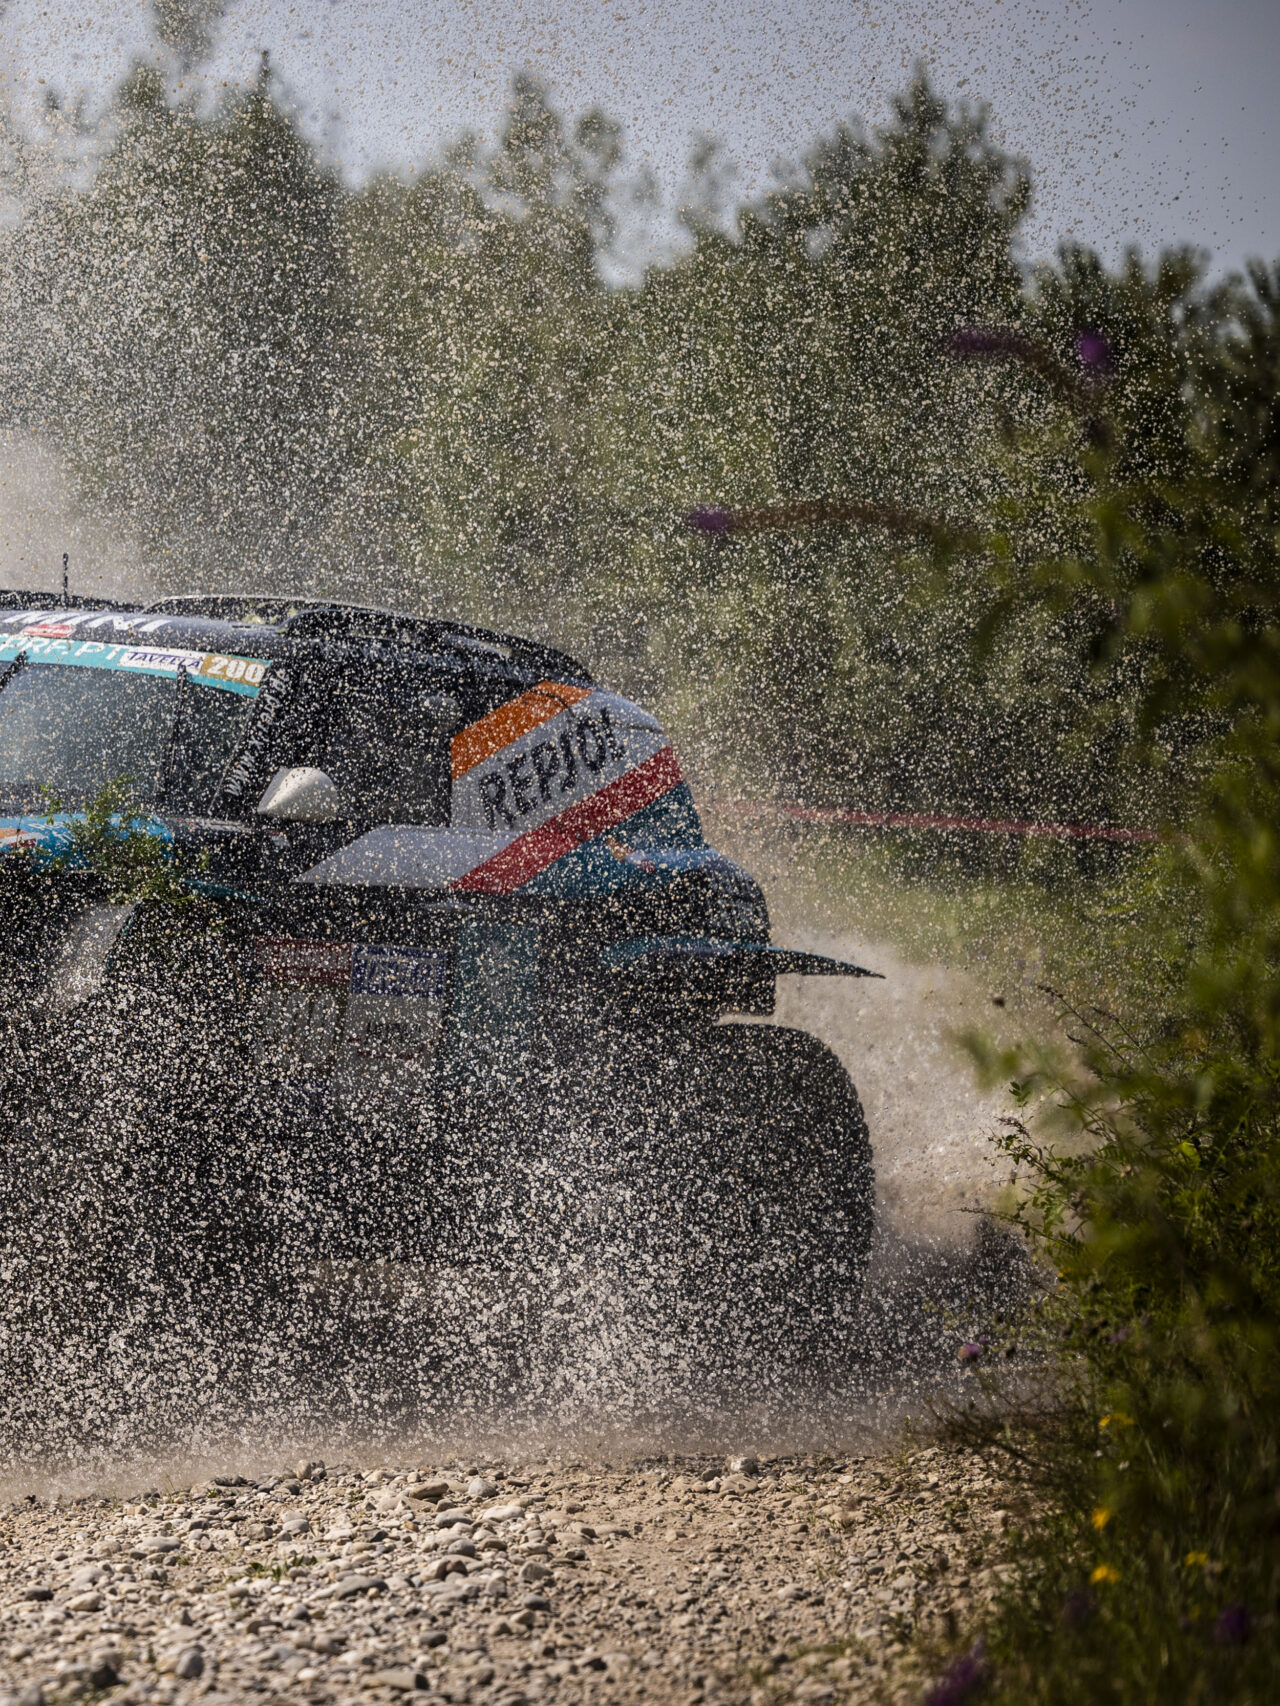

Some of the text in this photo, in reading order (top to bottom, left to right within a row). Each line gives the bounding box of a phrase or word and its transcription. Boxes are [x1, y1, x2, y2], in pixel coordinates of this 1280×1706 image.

[1, 611, 173, 633] MINI
[128, 651, 201, 669] TAVELLA
[206, 656, 266, 683] 200
[479, 707, 627, 832] REPSOL
